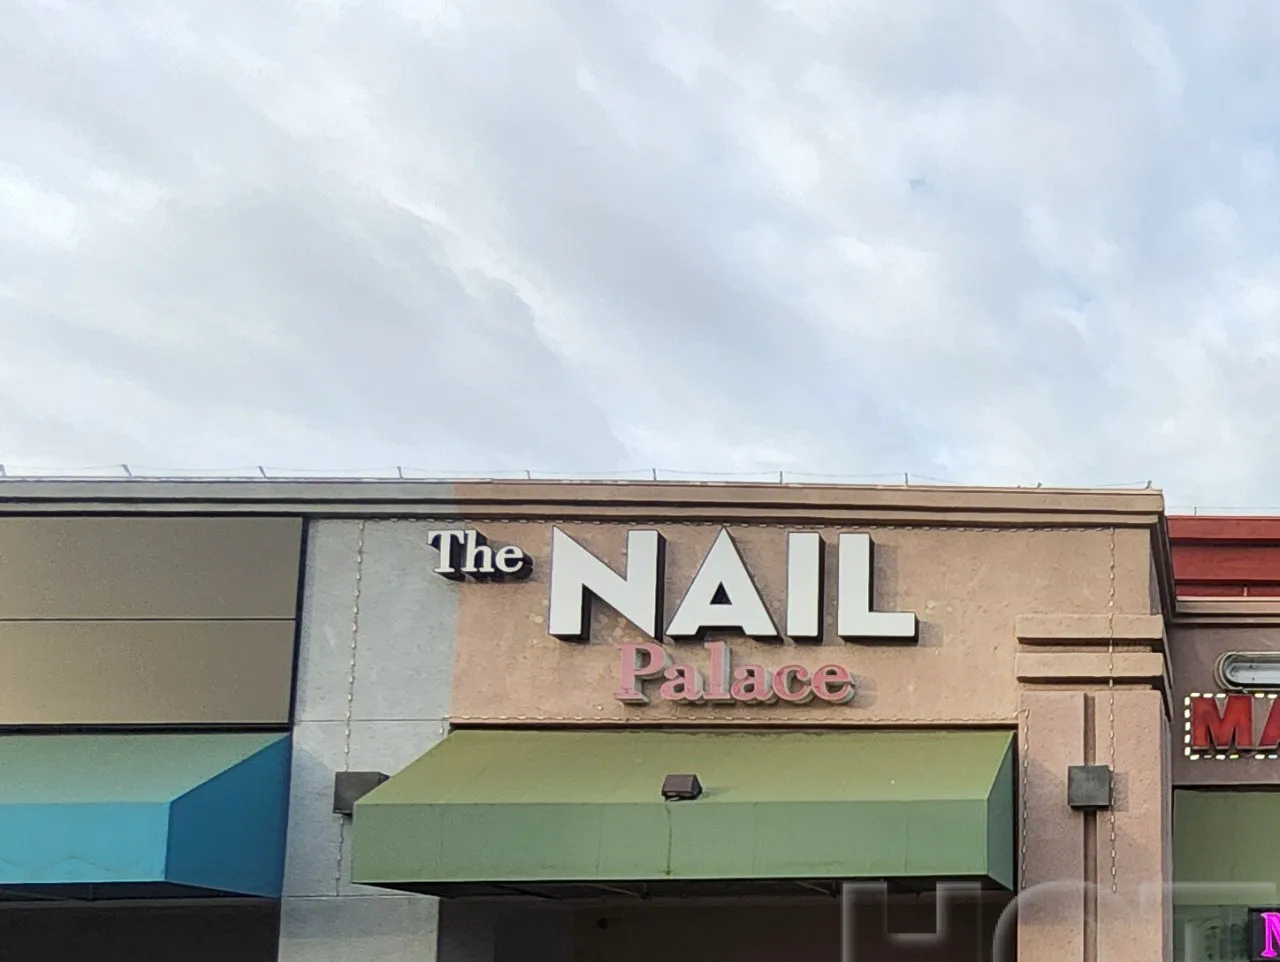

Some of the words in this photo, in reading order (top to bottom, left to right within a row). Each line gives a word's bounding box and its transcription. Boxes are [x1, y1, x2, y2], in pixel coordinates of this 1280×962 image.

[427, 528, 525, 575] The
[549, 526, 917, 639] NAIL
[615, 641, 855, 703] Palace
